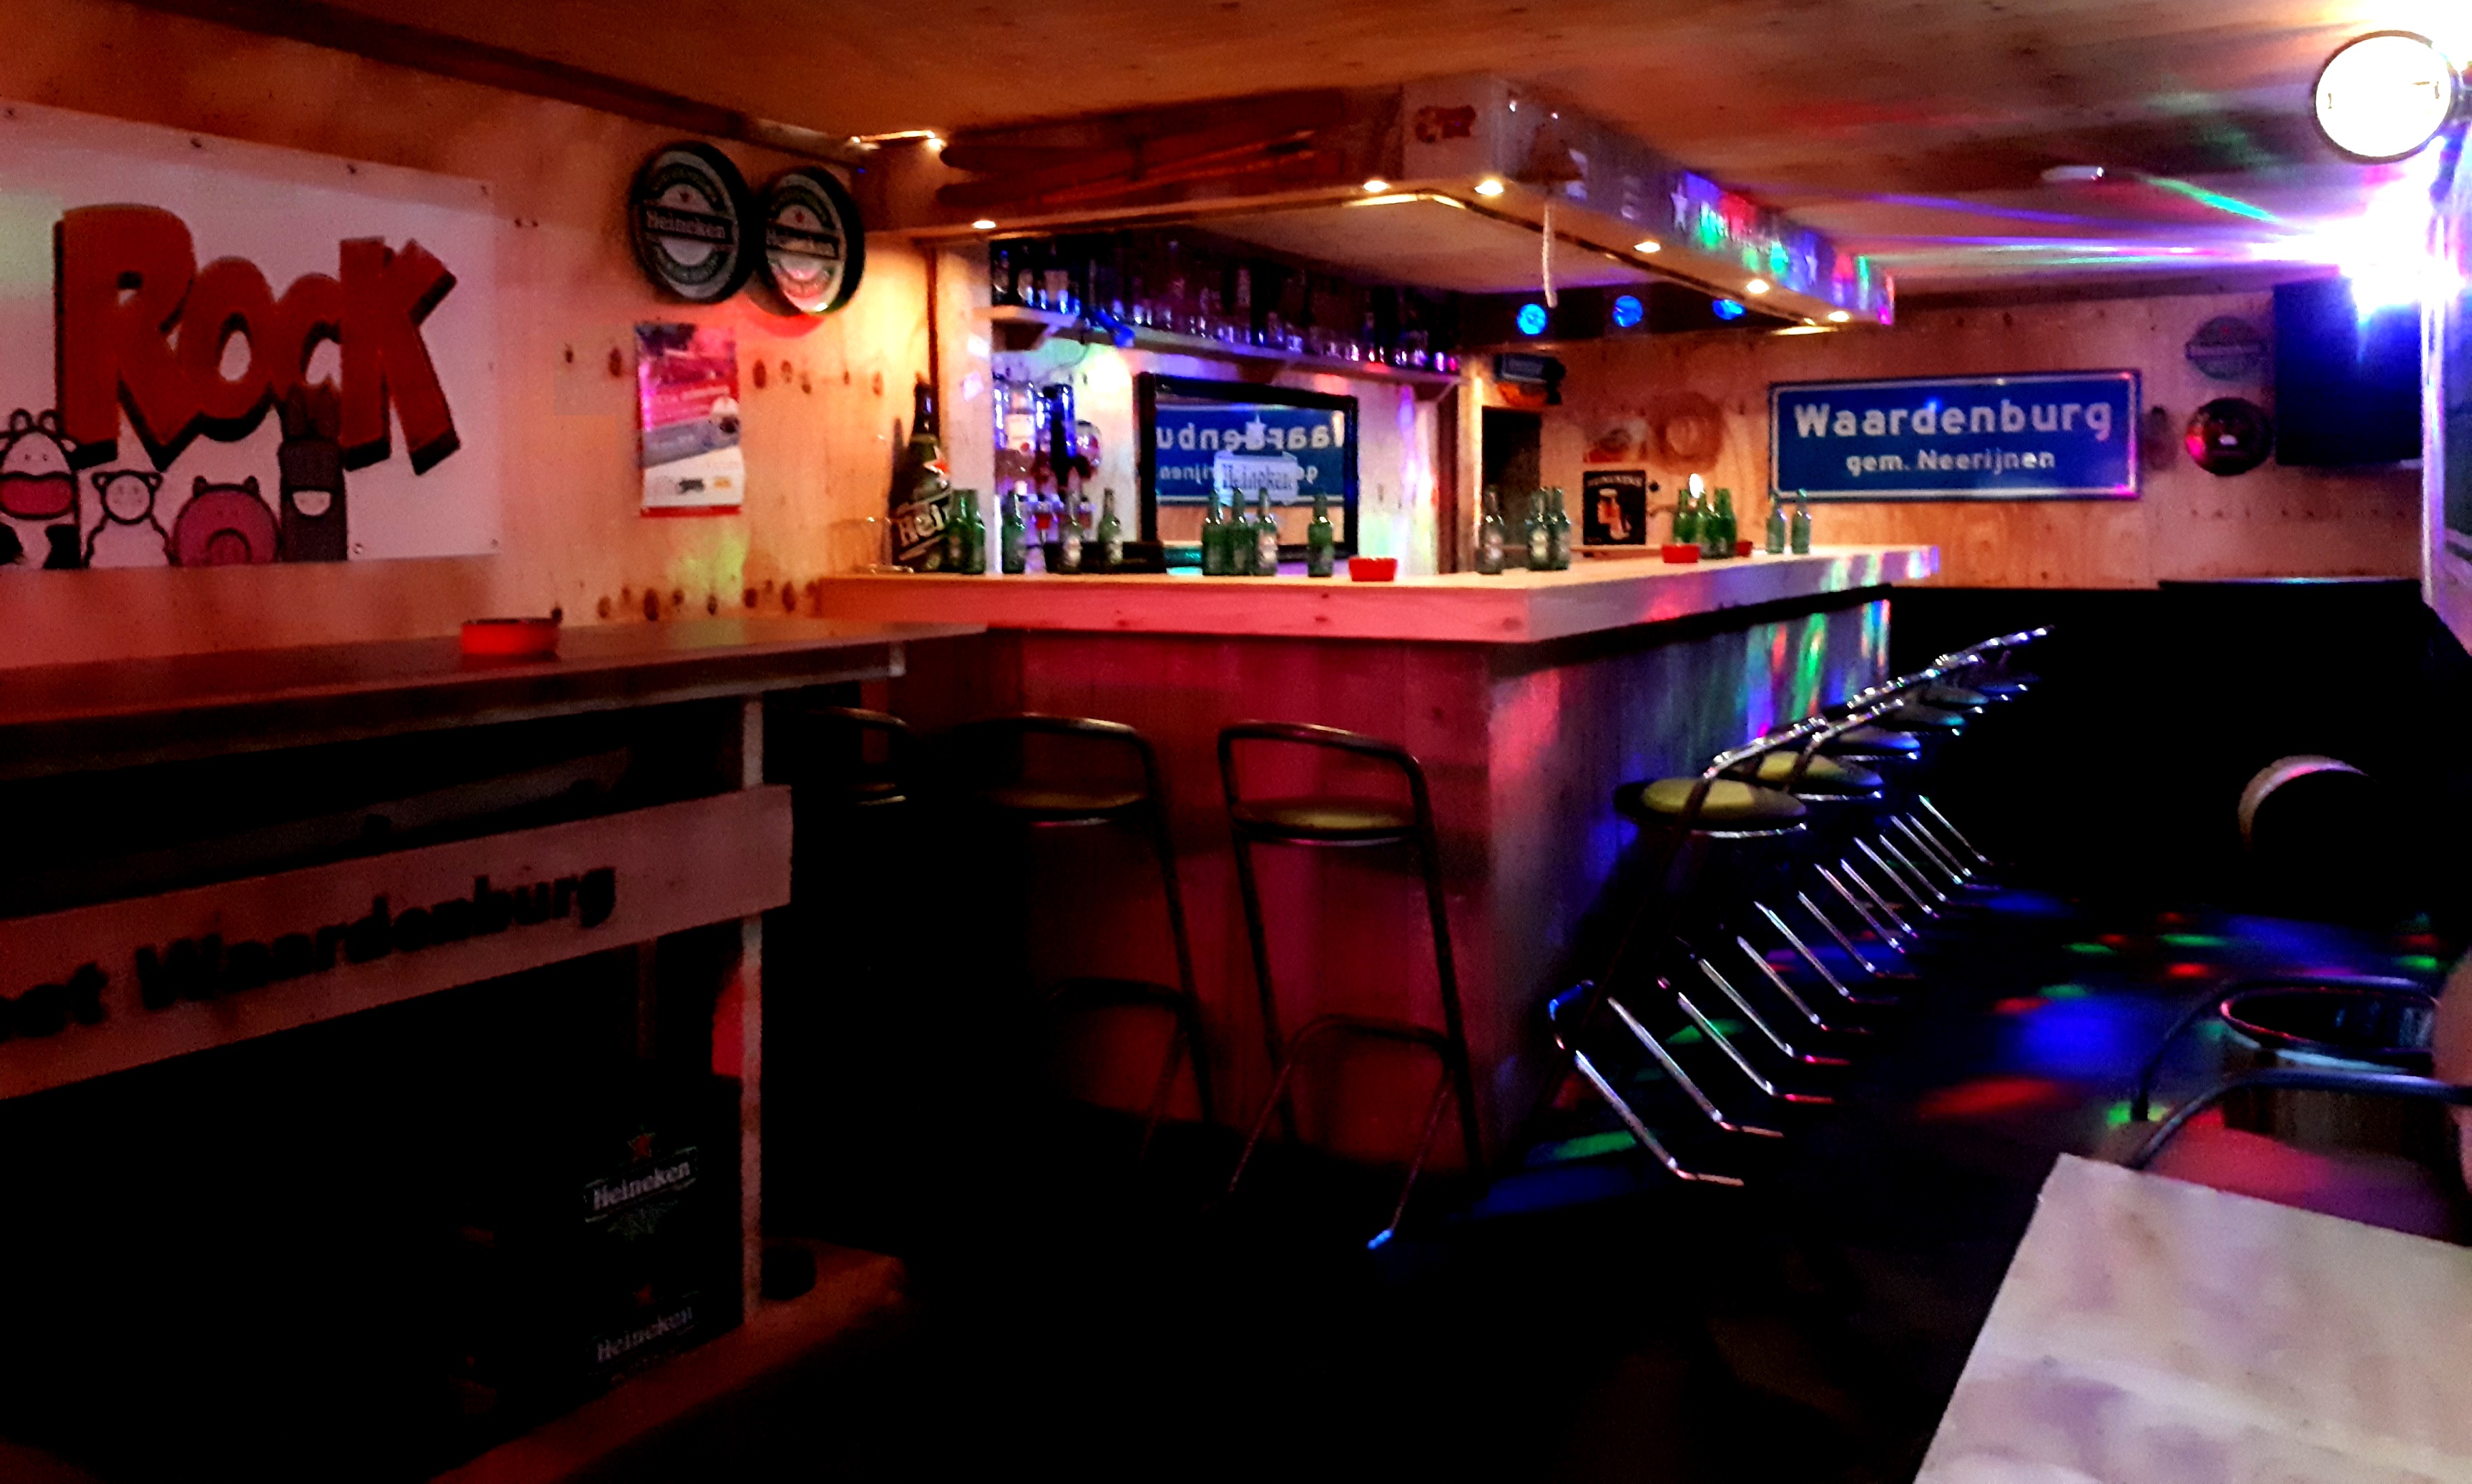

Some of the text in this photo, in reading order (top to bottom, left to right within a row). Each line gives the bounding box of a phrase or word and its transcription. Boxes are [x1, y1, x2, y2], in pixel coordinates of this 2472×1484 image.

[646, 209, 725, 239] Heineken
[1794, 399, 2112, 441] Waardenburg
[1222, 463, 1292, 490] Heineken
[1846, 449, 2055, 476] gem. Neerijnen
[593, 1161, 690, 1212] Heineken
[596, 1306, 692, 1363] Heineken
